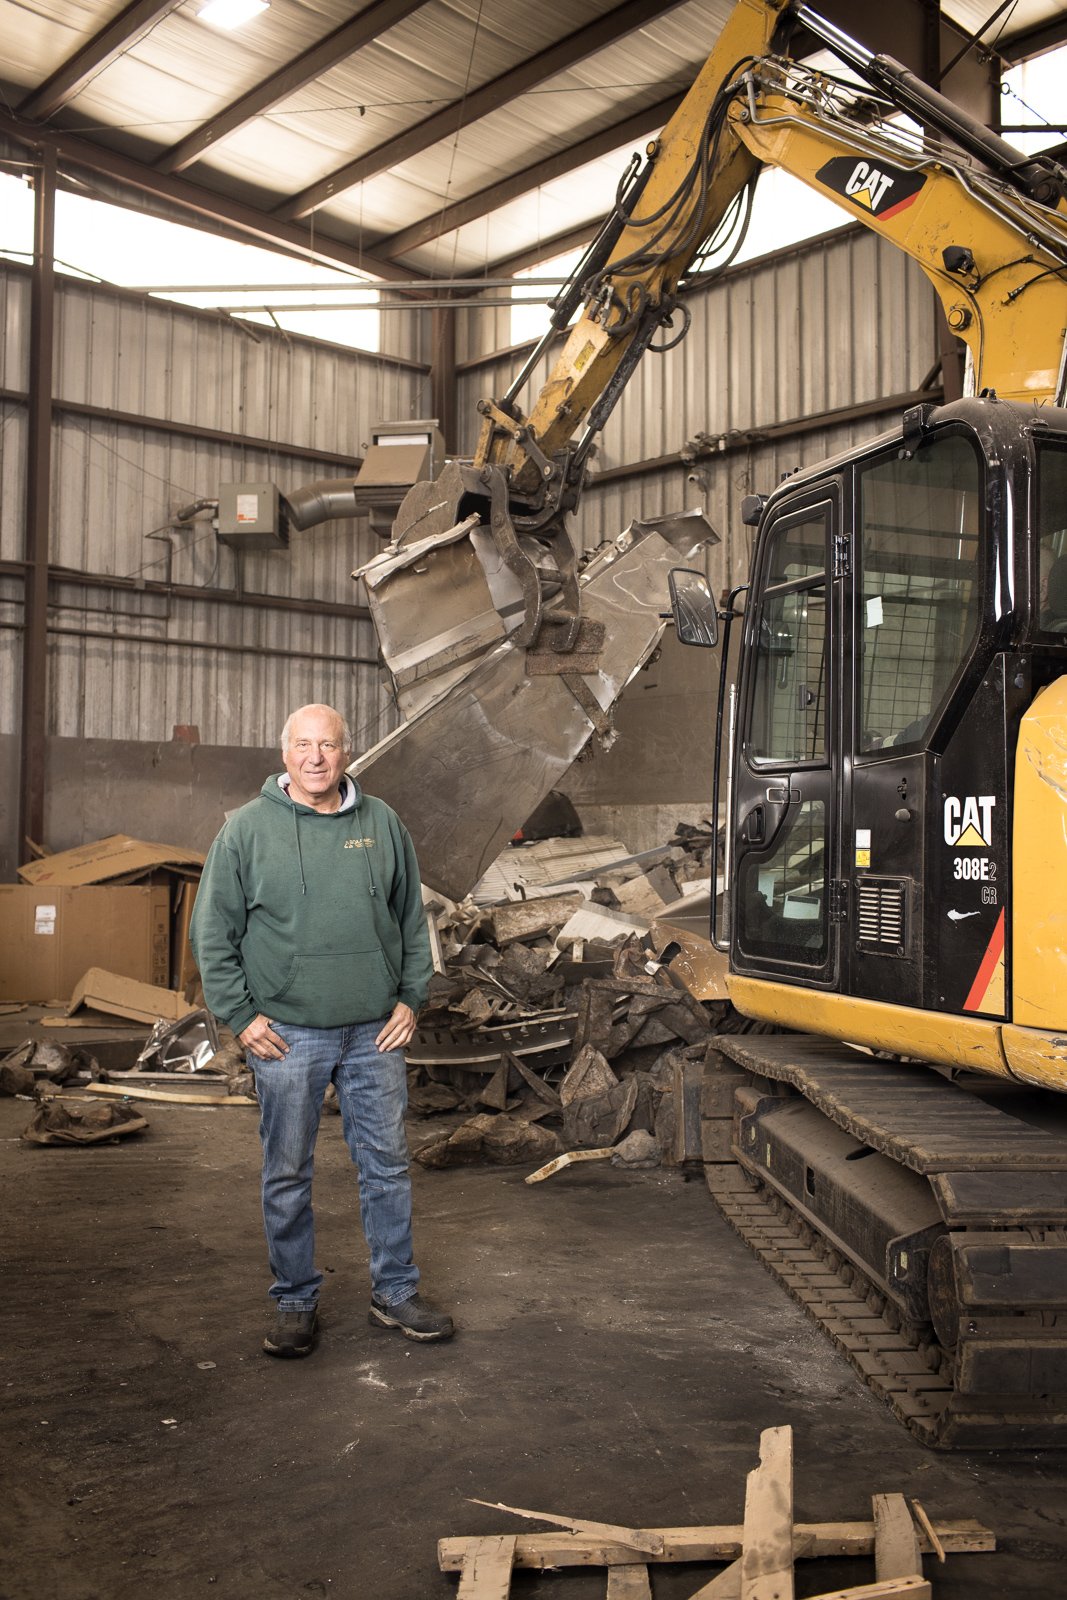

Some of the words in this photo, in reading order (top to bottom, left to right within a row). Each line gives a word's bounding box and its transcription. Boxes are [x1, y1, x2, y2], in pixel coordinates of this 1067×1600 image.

[845, 161, 894, 211] CAT
[944, 796, 996, 846] CAT
[981, 886, 997, 905] CR
